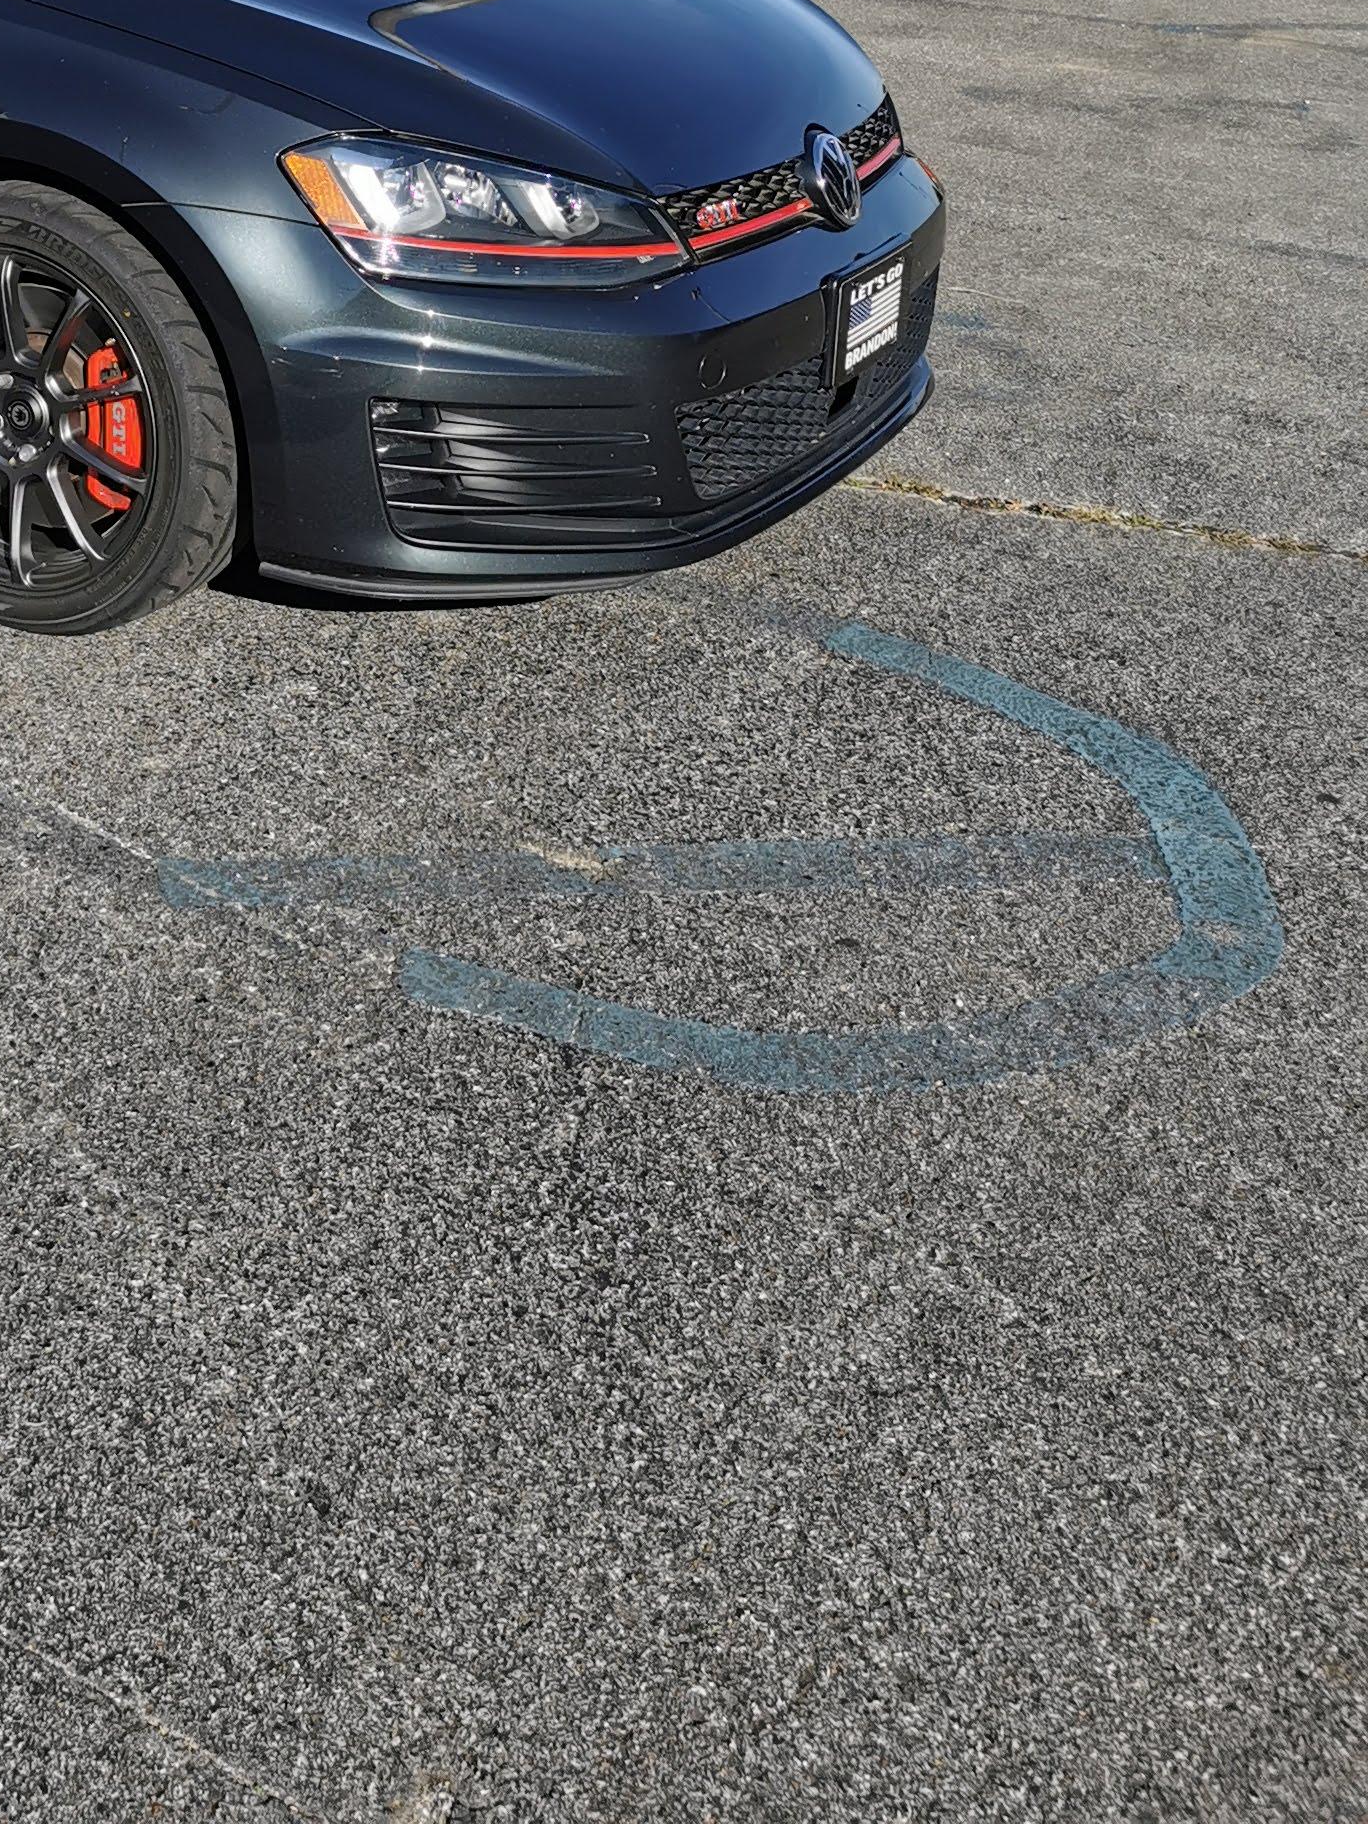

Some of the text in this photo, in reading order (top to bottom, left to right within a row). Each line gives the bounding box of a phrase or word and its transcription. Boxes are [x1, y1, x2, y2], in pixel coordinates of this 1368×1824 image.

[851, 263, 904, 305] LET'S GO
[845, 321, 898, 371] BRANDON!
[112, 401, 127, 456] GTI
